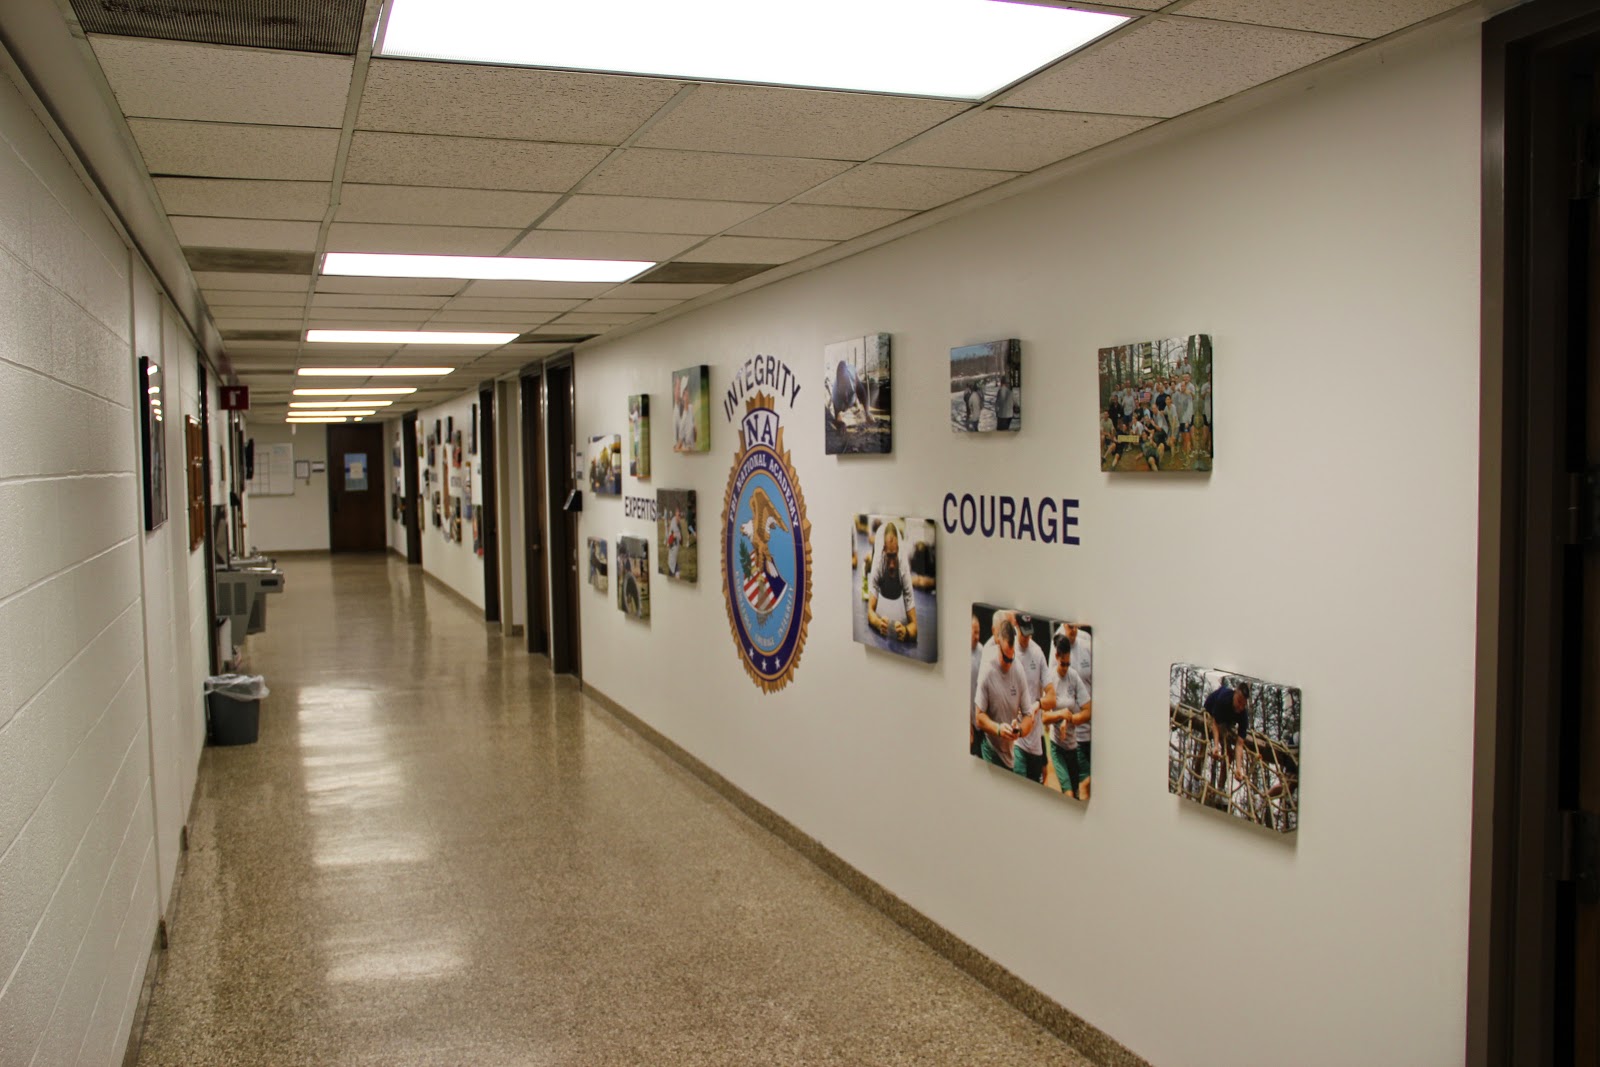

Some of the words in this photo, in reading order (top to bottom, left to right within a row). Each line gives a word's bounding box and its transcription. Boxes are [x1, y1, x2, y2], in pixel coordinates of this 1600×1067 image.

[724, 354, 801, 423] INTEGRITY
[746, 414, 774, 448] NA
[625, 496, 658, 522] EXPERTIS
[736, 454, 767, 493] NATIONAL
[769, 459, 799, 528] ACADEMY
[943, 492, 1080, 546] COURAGE
